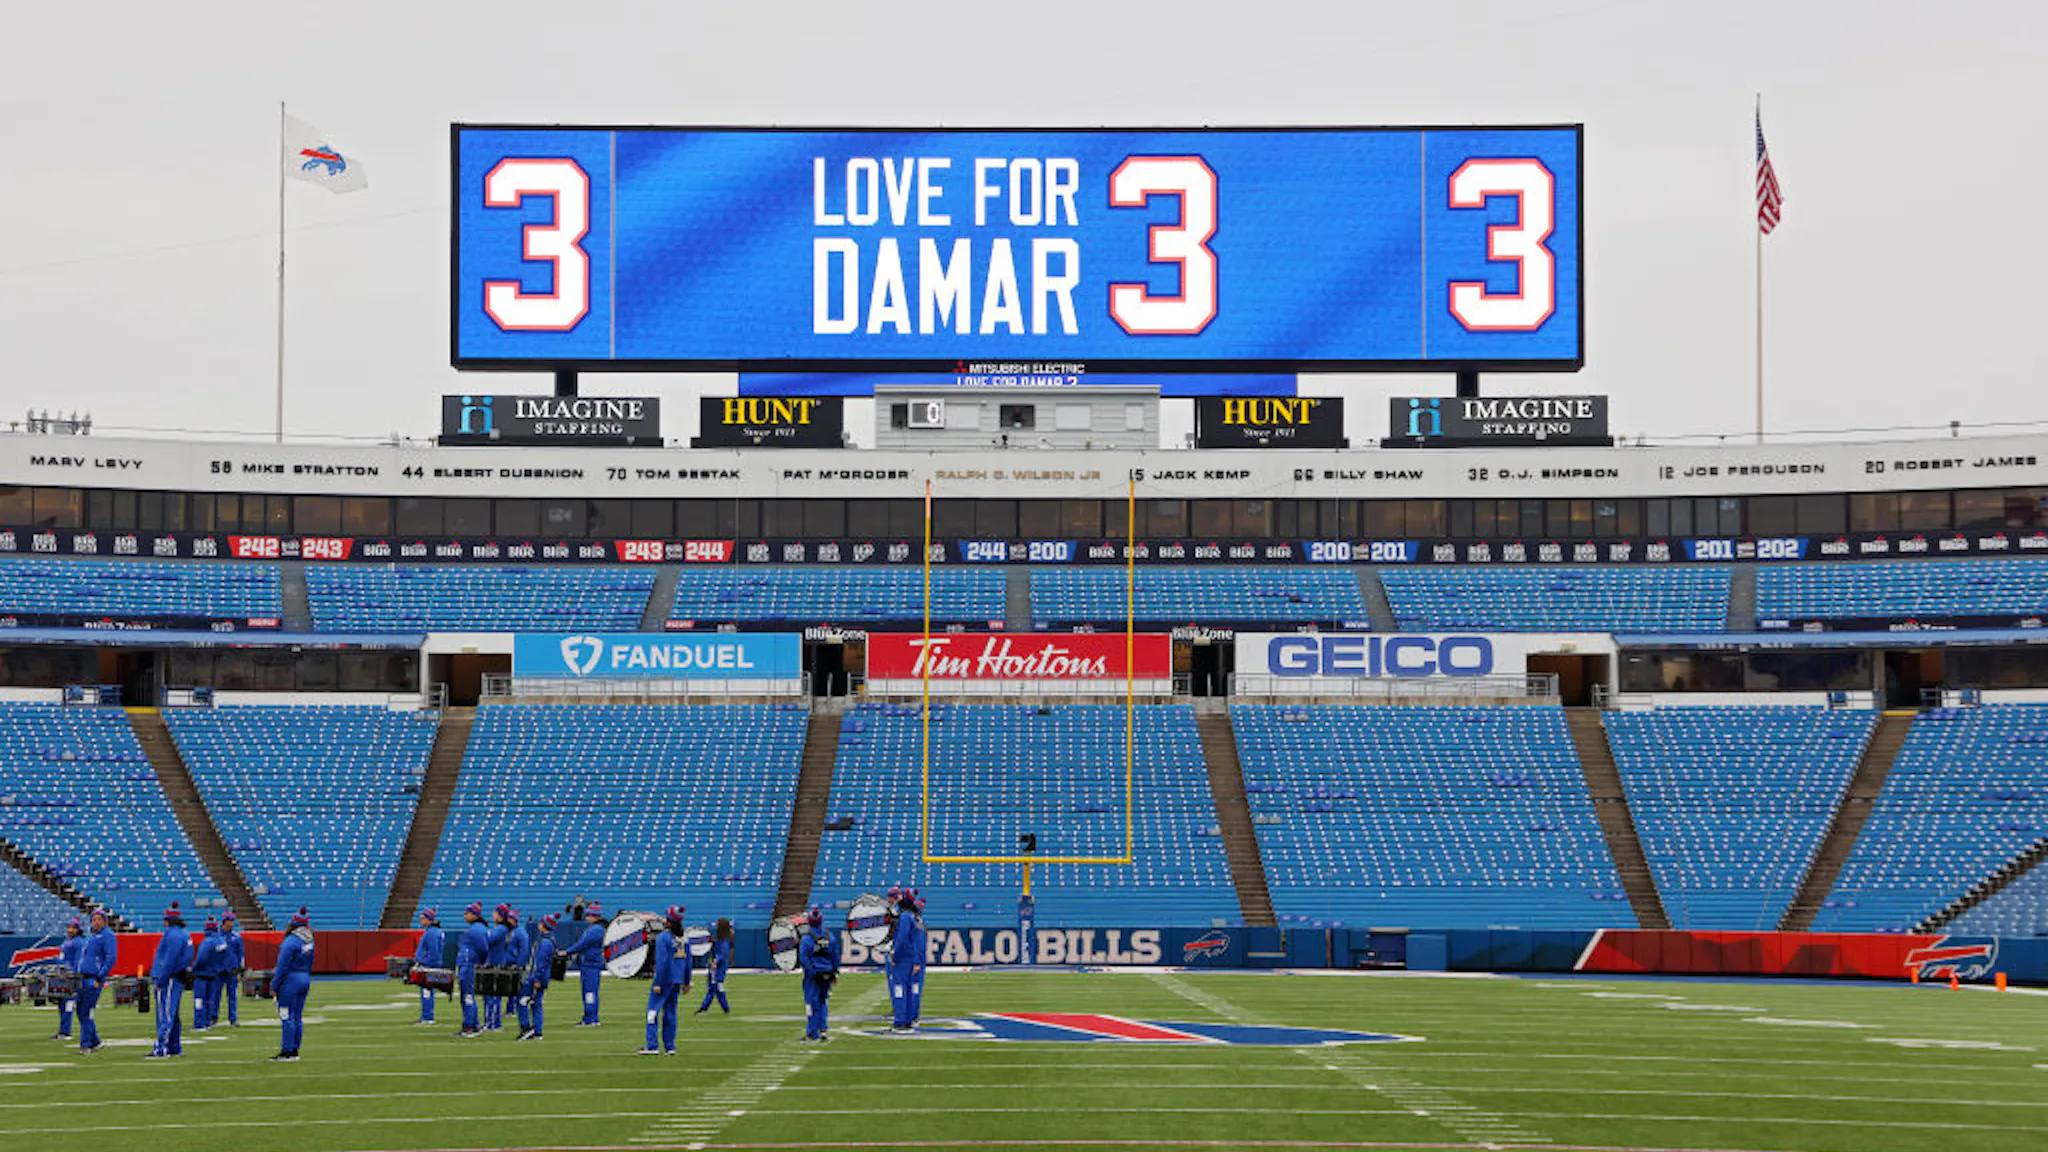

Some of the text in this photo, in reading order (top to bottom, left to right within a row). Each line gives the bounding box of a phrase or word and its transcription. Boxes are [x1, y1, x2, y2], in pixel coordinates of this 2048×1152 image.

[813, 157, 1080, 226] LOVE FOR
[483, 156, 590, 331] 3
[1109, 154, 1218, 335] 3
[1448, 157, 1555, 332] 3
[813, 238, 1080, 335] DAMAR
[969, 363, 1085, 374] MITSUBISHI ELECTRIC
[515, 399, 644, 420] IMAGINE
[722, 398, 816, 424] HUNT
[1222, 398, 1317, 424] HUNT
[1462, 399, 1594, 420] IMAGINE
[534, 422, 624, 435] STAFFING
[1482, 422, 1572, 434] STAFFING
[30, 456, 143, 470] MARV LEVY
[211, 460, 378, 476] 58 MIKE STRATTON
[1660, 464, 1824, 480] 12 JOE FERGUSON
[1866, 457, 2037, 474] 20 ROBERT JAMES
[402, 466, 583, 479] 44 ELBERT DUBENION
[607, 467, 740, 480] 70 TOM SESTAK
[783, 470, 908, 479] PAT MGRODER
[935, 470, 987, 480] RALPH
[1013, 470, 1075, 480] WILSON
[1129, 469, 1250, 481] 15 JACK KEMP
[1294, 469, 1423, 482] 66 BILLY SHAW
[1469, 468, 1618, 481] 32 O.J. SIMPSON
[239, 537, 280, 556] 242
[302, 539, 343, 558] 243
[625, 542, 663, 560] 243
[685, 542, 725, 560] 244
[967, 542, 1005, 560] 244
[1029, 542, 1067, 560] 200
[1311, 542, 1350, 560] 200
[1370, 542, 1407, 560] 201
[1695, 539, 1733, 558] 201
[1757, 538, 1799, 558] 202
[612, 645, 753, 668] FANDUEL
[908, 636, 1106, 678] Tim Hortons
[1267, 636, 1493, 677] GEICO
[842, 930, 1018, 964] BFALO
[1036, 930, 1161, 964] BILLS
